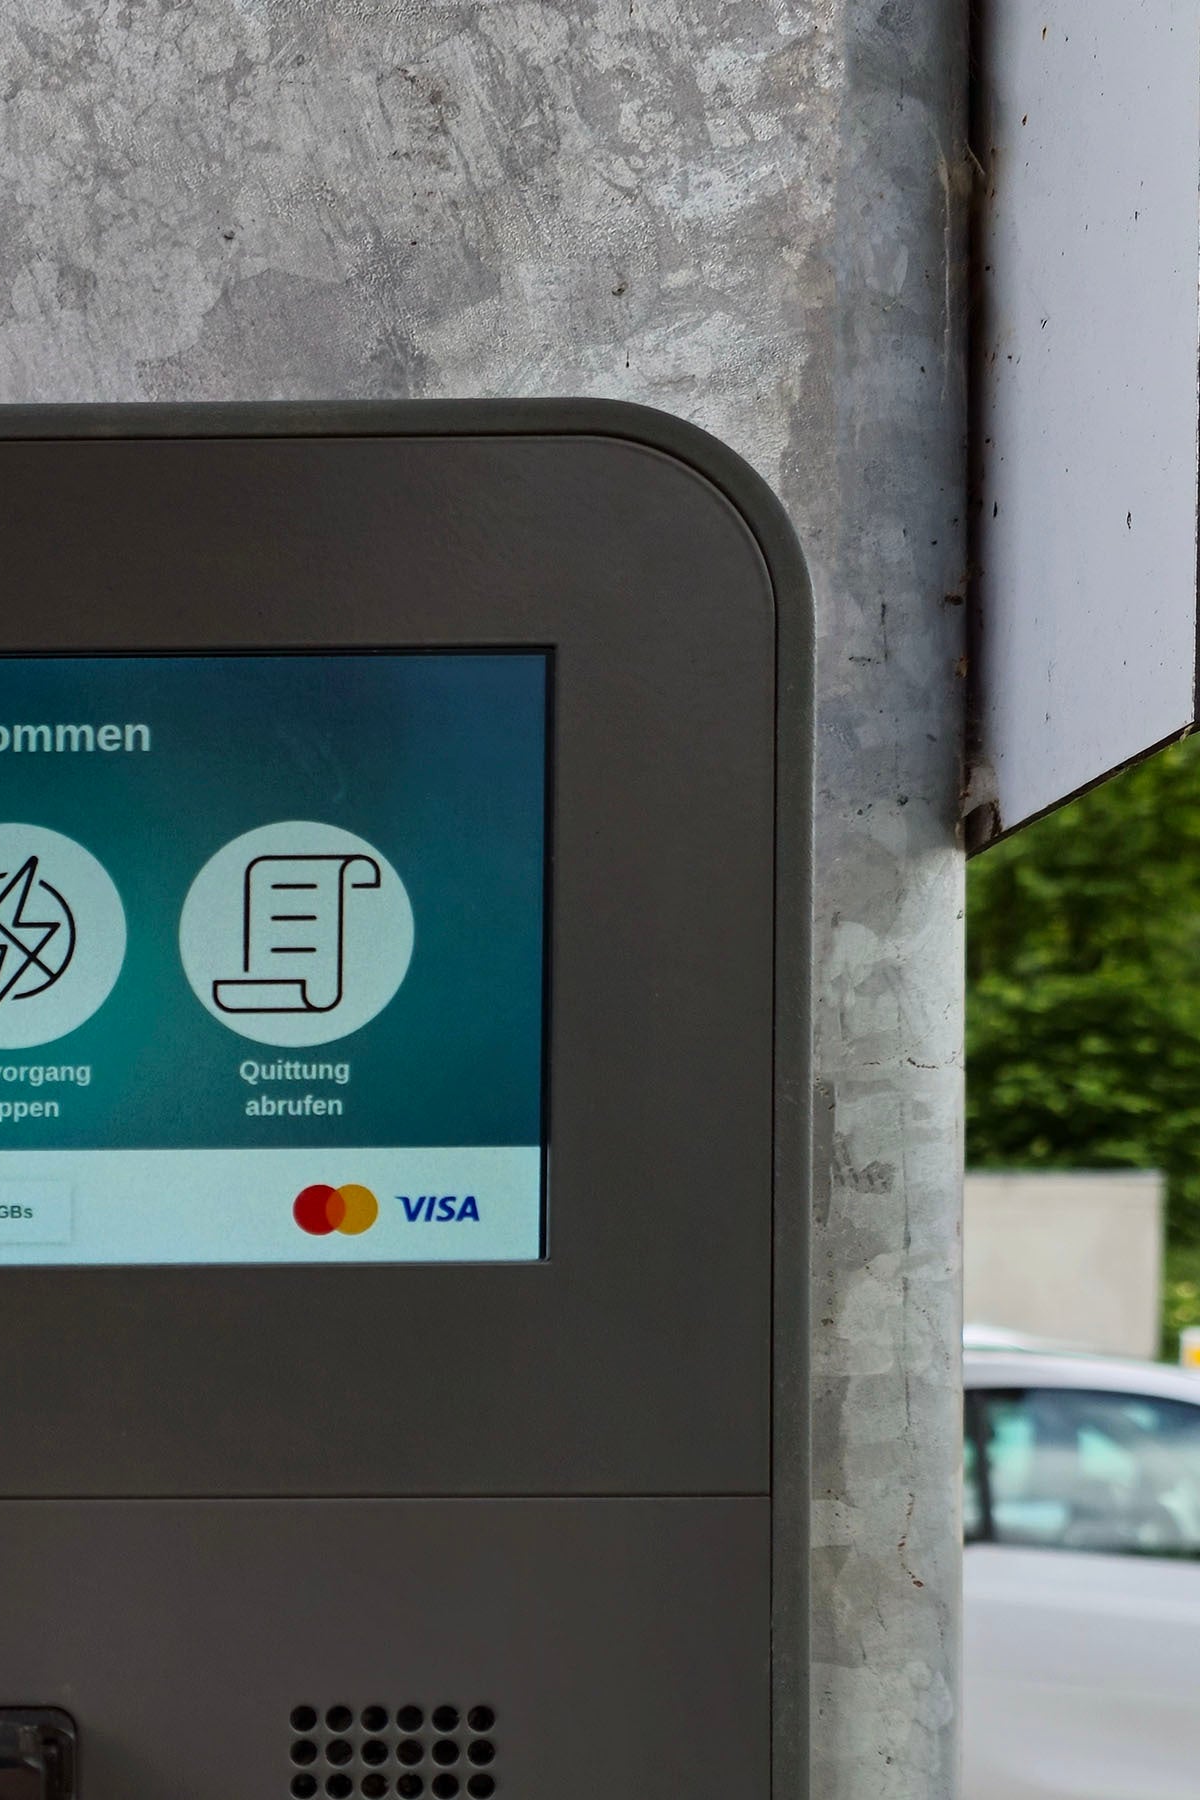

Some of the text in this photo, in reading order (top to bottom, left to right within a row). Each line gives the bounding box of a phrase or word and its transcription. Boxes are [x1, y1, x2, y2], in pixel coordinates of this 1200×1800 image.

[238, 1059, 351, 1085] Quittung
[245, 1095, 343, 1117] abrufen
[394, 1196, 480, 1222] VISA
